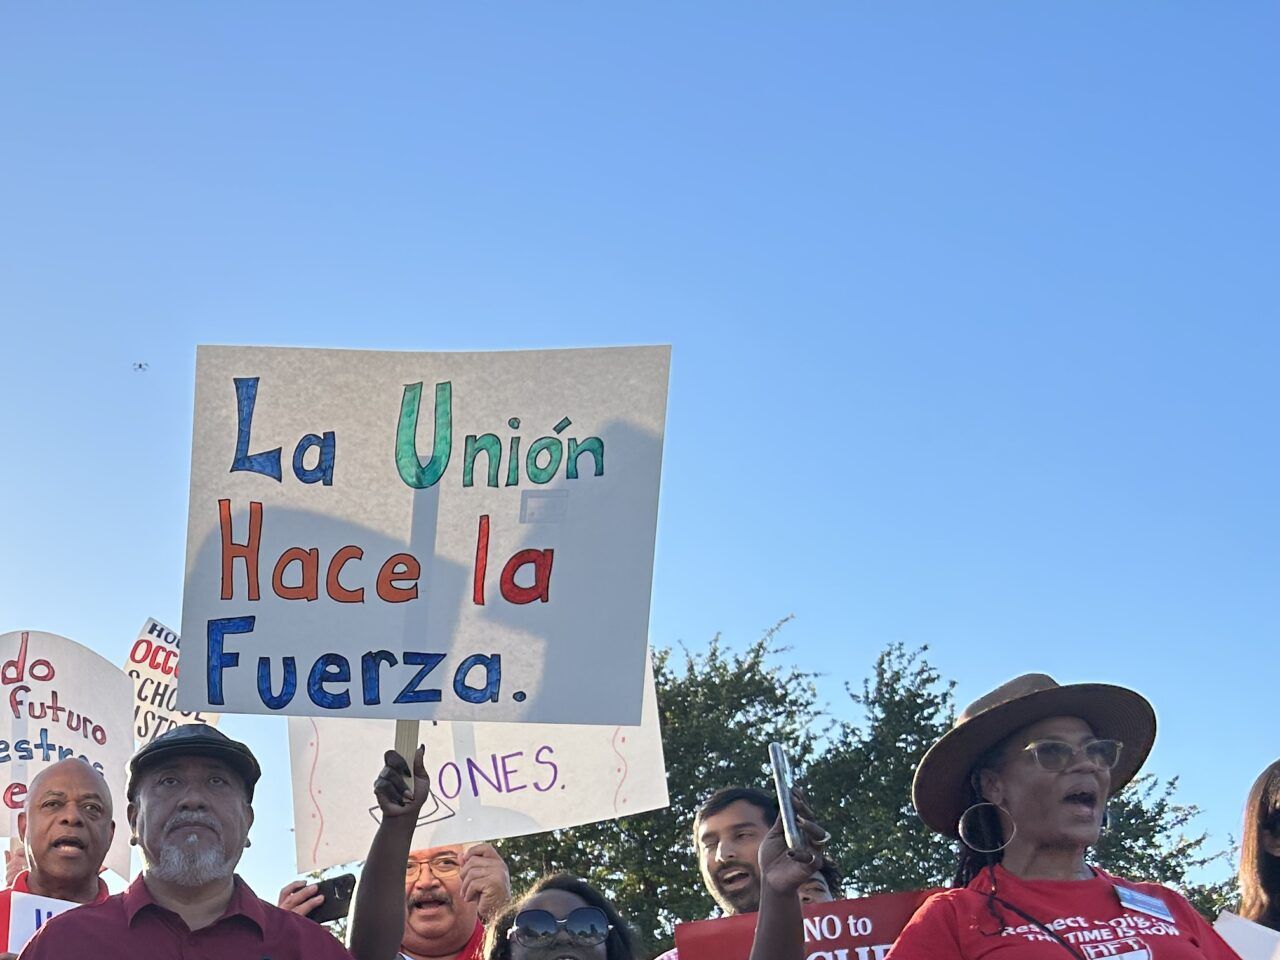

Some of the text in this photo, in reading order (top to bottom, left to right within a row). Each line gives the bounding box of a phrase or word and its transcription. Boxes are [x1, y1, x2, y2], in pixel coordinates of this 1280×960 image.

[230, 376, 605, 489] La Unión
[218, 498, 555, 605] Hace la
[129, 639, 179, 679] OCC
[206, 615, 528, 710] Fuerza.
[10, 684, 107, 746] futuro
[438, 744, 567, 800] ONES.
[803, 914, 872, 942] NO to
[1063, 928, 1114, 944] TIME
[1116, 924, 1136, 938] IS
[1084, 936, 1140, 960] HFT
